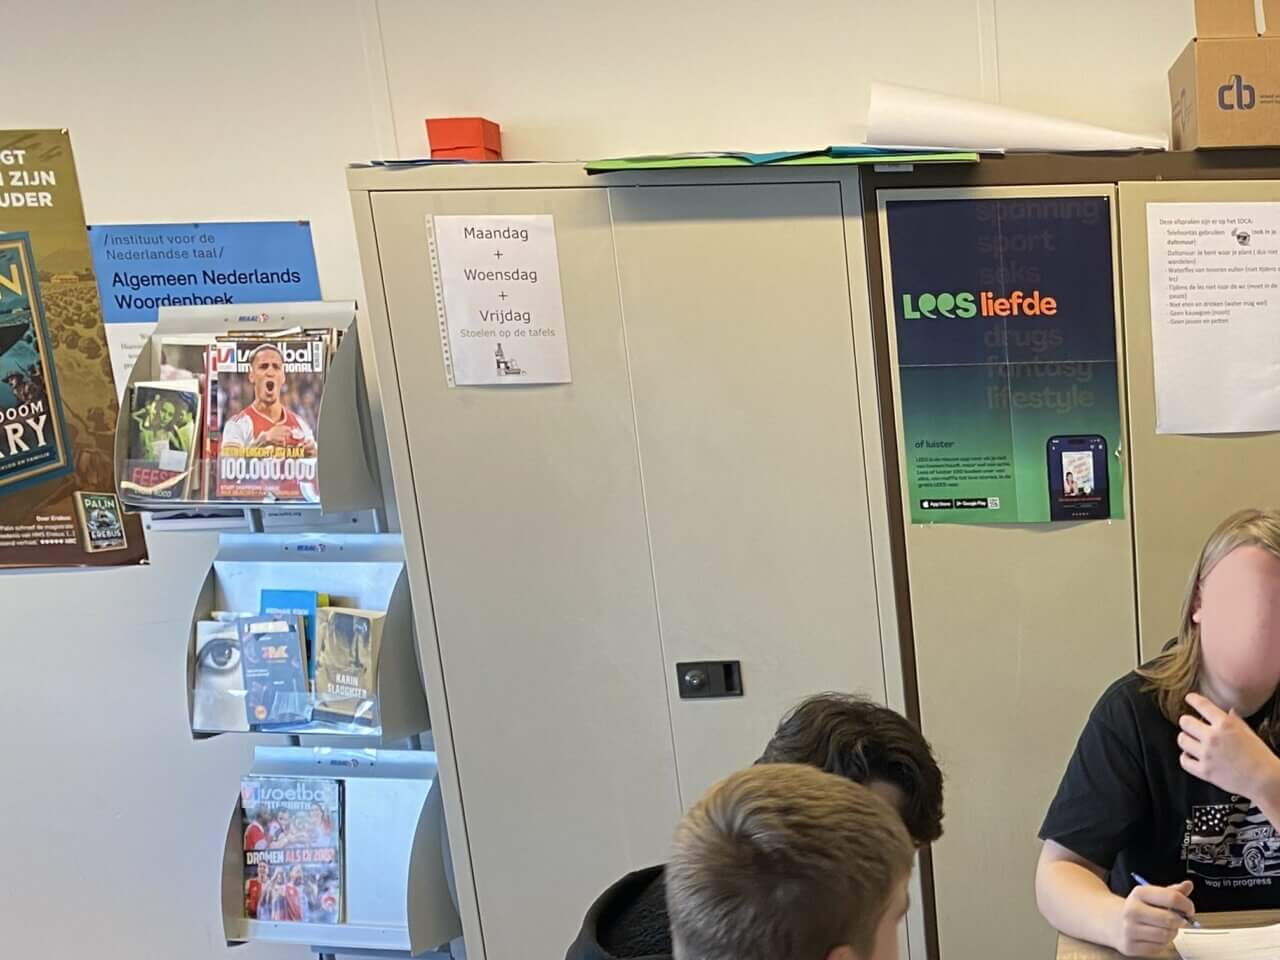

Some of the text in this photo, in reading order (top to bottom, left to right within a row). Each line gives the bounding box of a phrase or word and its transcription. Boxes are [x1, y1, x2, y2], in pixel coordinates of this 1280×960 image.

[8, 170, 56, 187] ZIJN
[167, 235, 196, 245] voor
[199, 232, 216, 244] de
[464, 227, 529, 242] Maandag
[106, 249, 189, 261] Nederlandse
[112, 268, 301, 291] Algemeen Nederlands
[464, 268, 538, 284] Woensdag
[980, 290, 1057, 317] liefde
[480, 309, 531, 324] Vrijdag
[460, 328, 556, 339] Stoelen op de tafels
[84, 499, 115, 508] PALIN
[1233, 877, 1272, 889] progress
